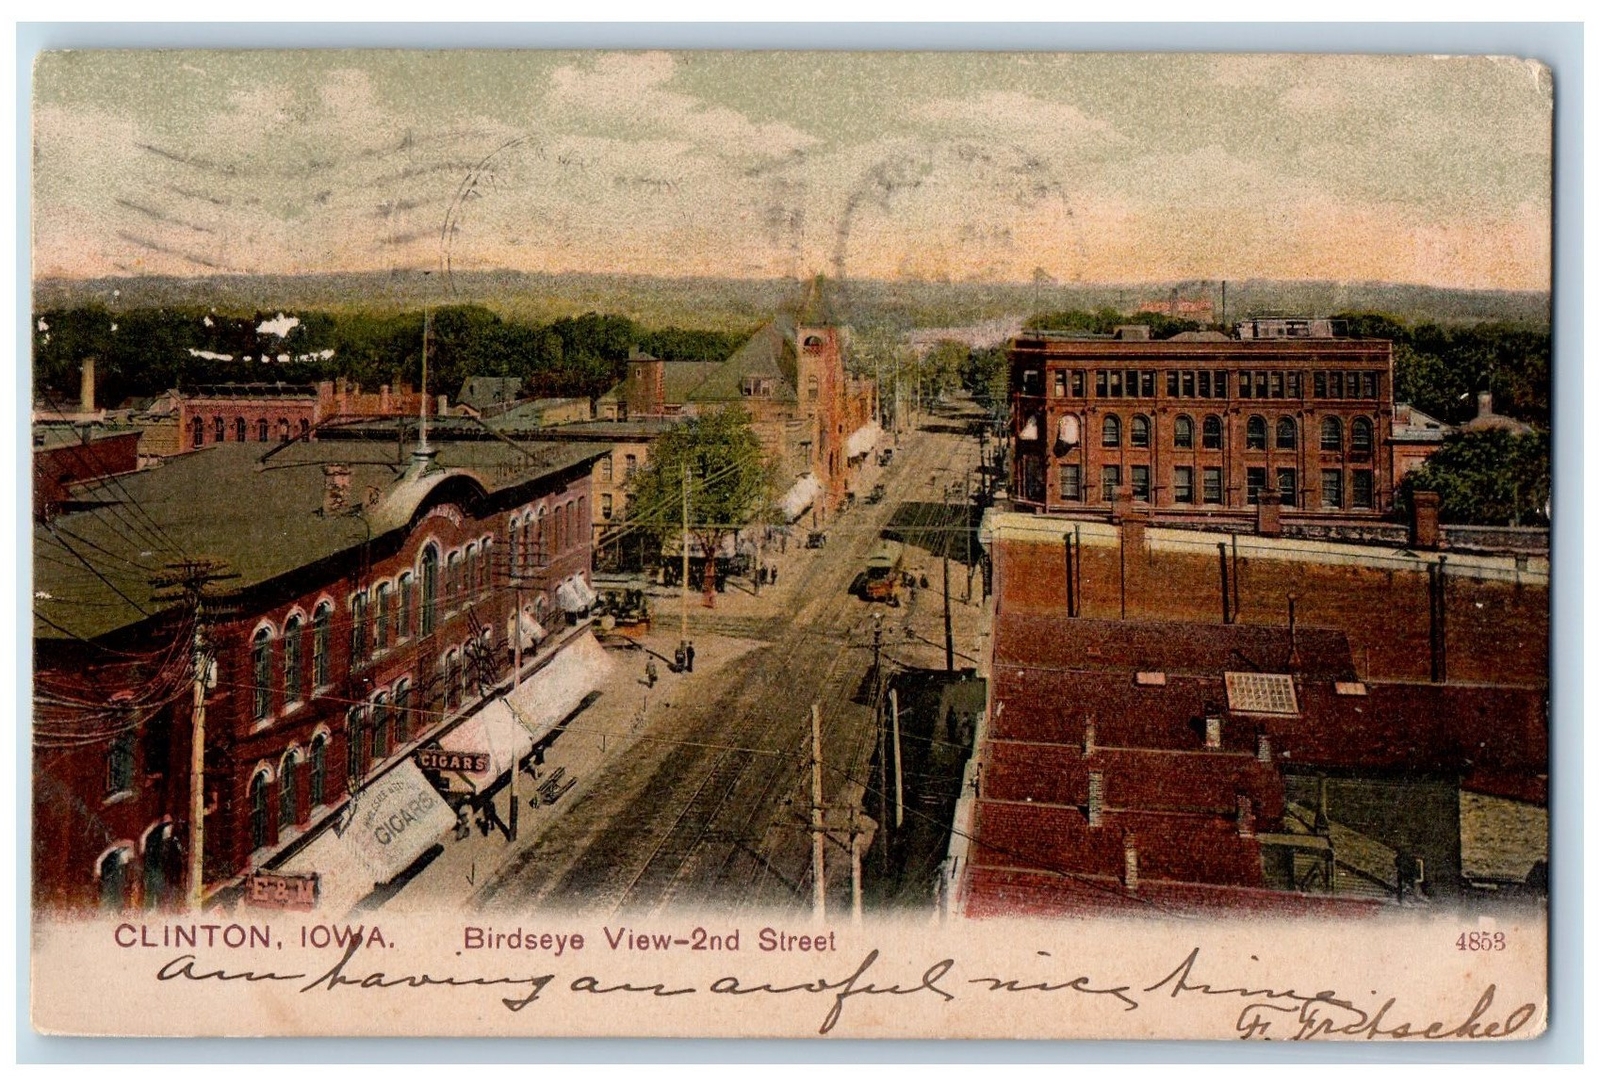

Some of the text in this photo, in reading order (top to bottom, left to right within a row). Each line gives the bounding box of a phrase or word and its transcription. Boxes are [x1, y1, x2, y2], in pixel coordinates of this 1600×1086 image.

[421, 754, 487, 771] CIGARS
[374, 790, 434, 845] CIGARS
[299, 930, 555, 1012] having
[570, 975, 697, 996] an
[709, 948, 956, 1036] awful
[967, 950, 1139, 1012] nice
